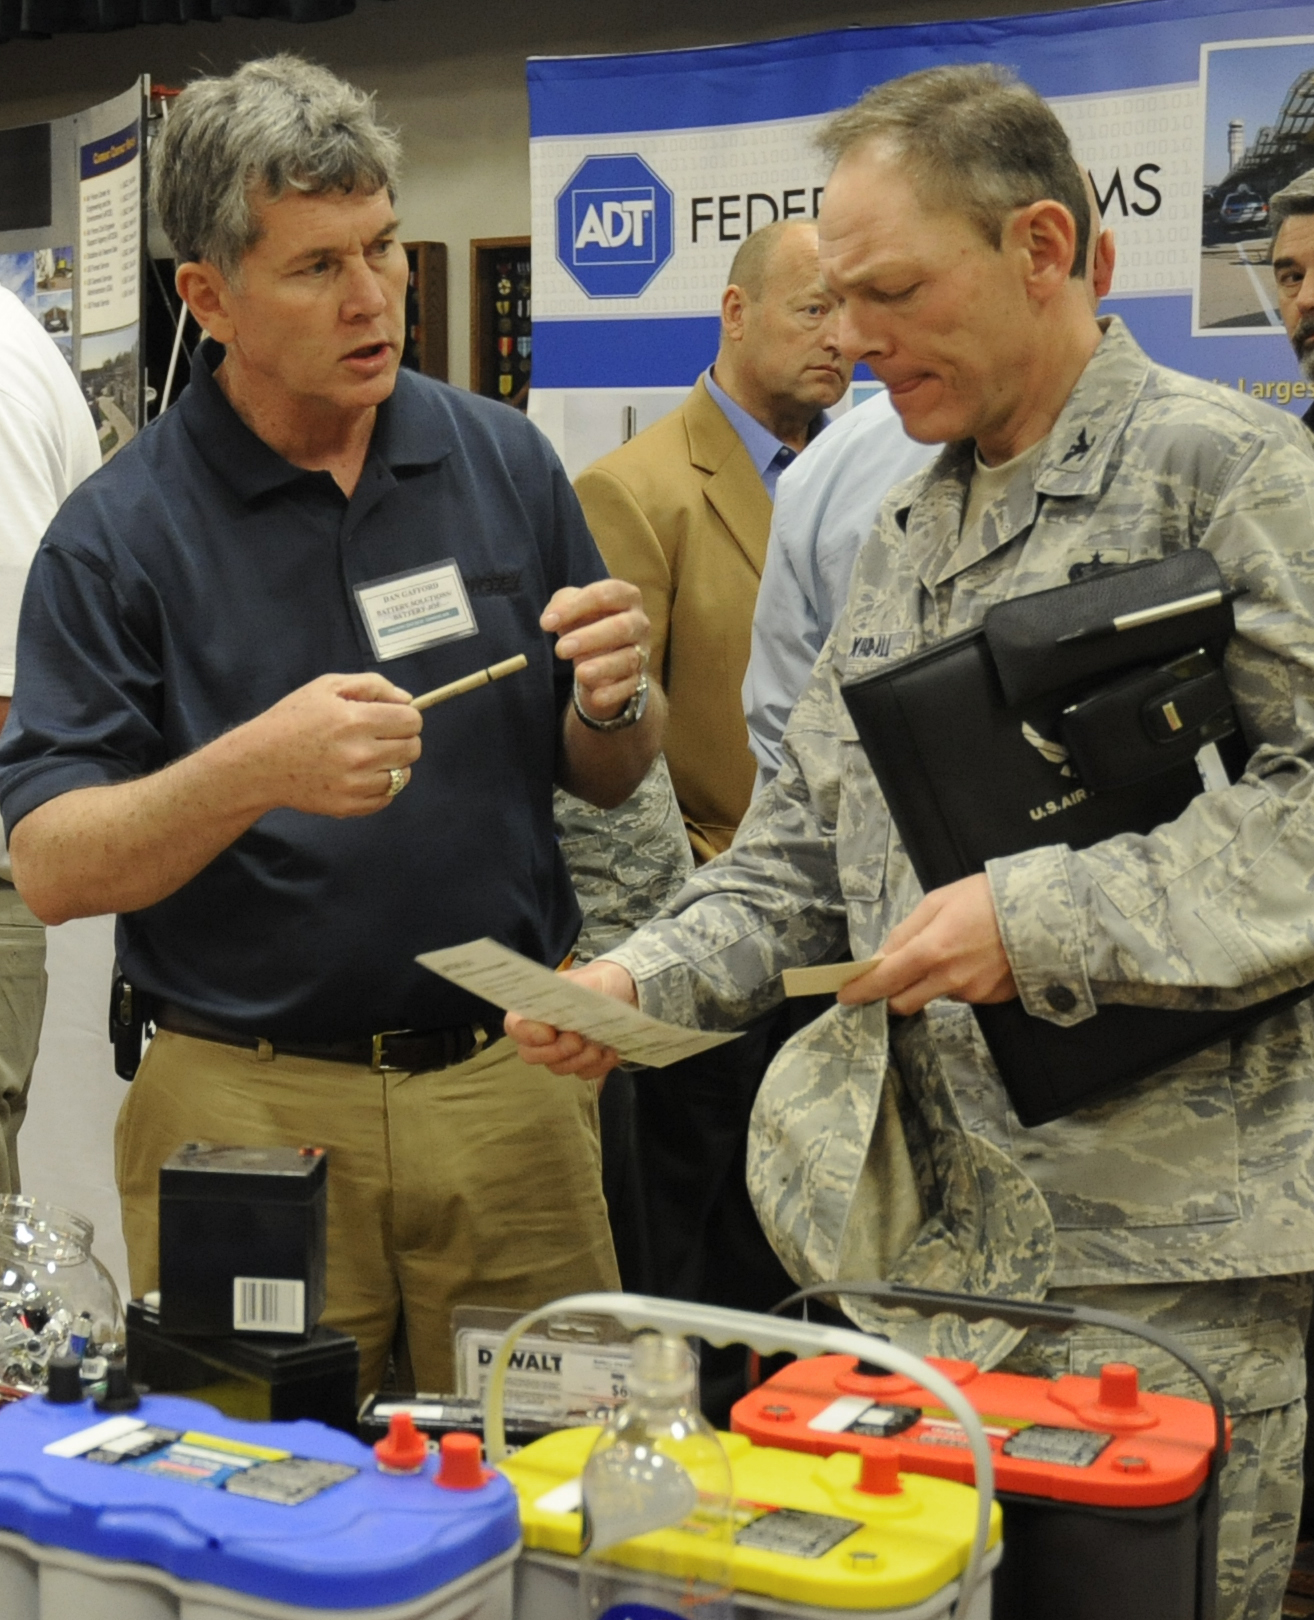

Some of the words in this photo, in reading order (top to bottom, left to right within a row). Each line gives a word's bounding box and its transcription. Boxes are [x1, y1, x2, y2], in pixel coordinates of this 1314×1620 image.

[575, 199, 653, 249] ADT
[383, 593, 400, 603] DAN
[478, 1349, 563, 1372] DWALT
